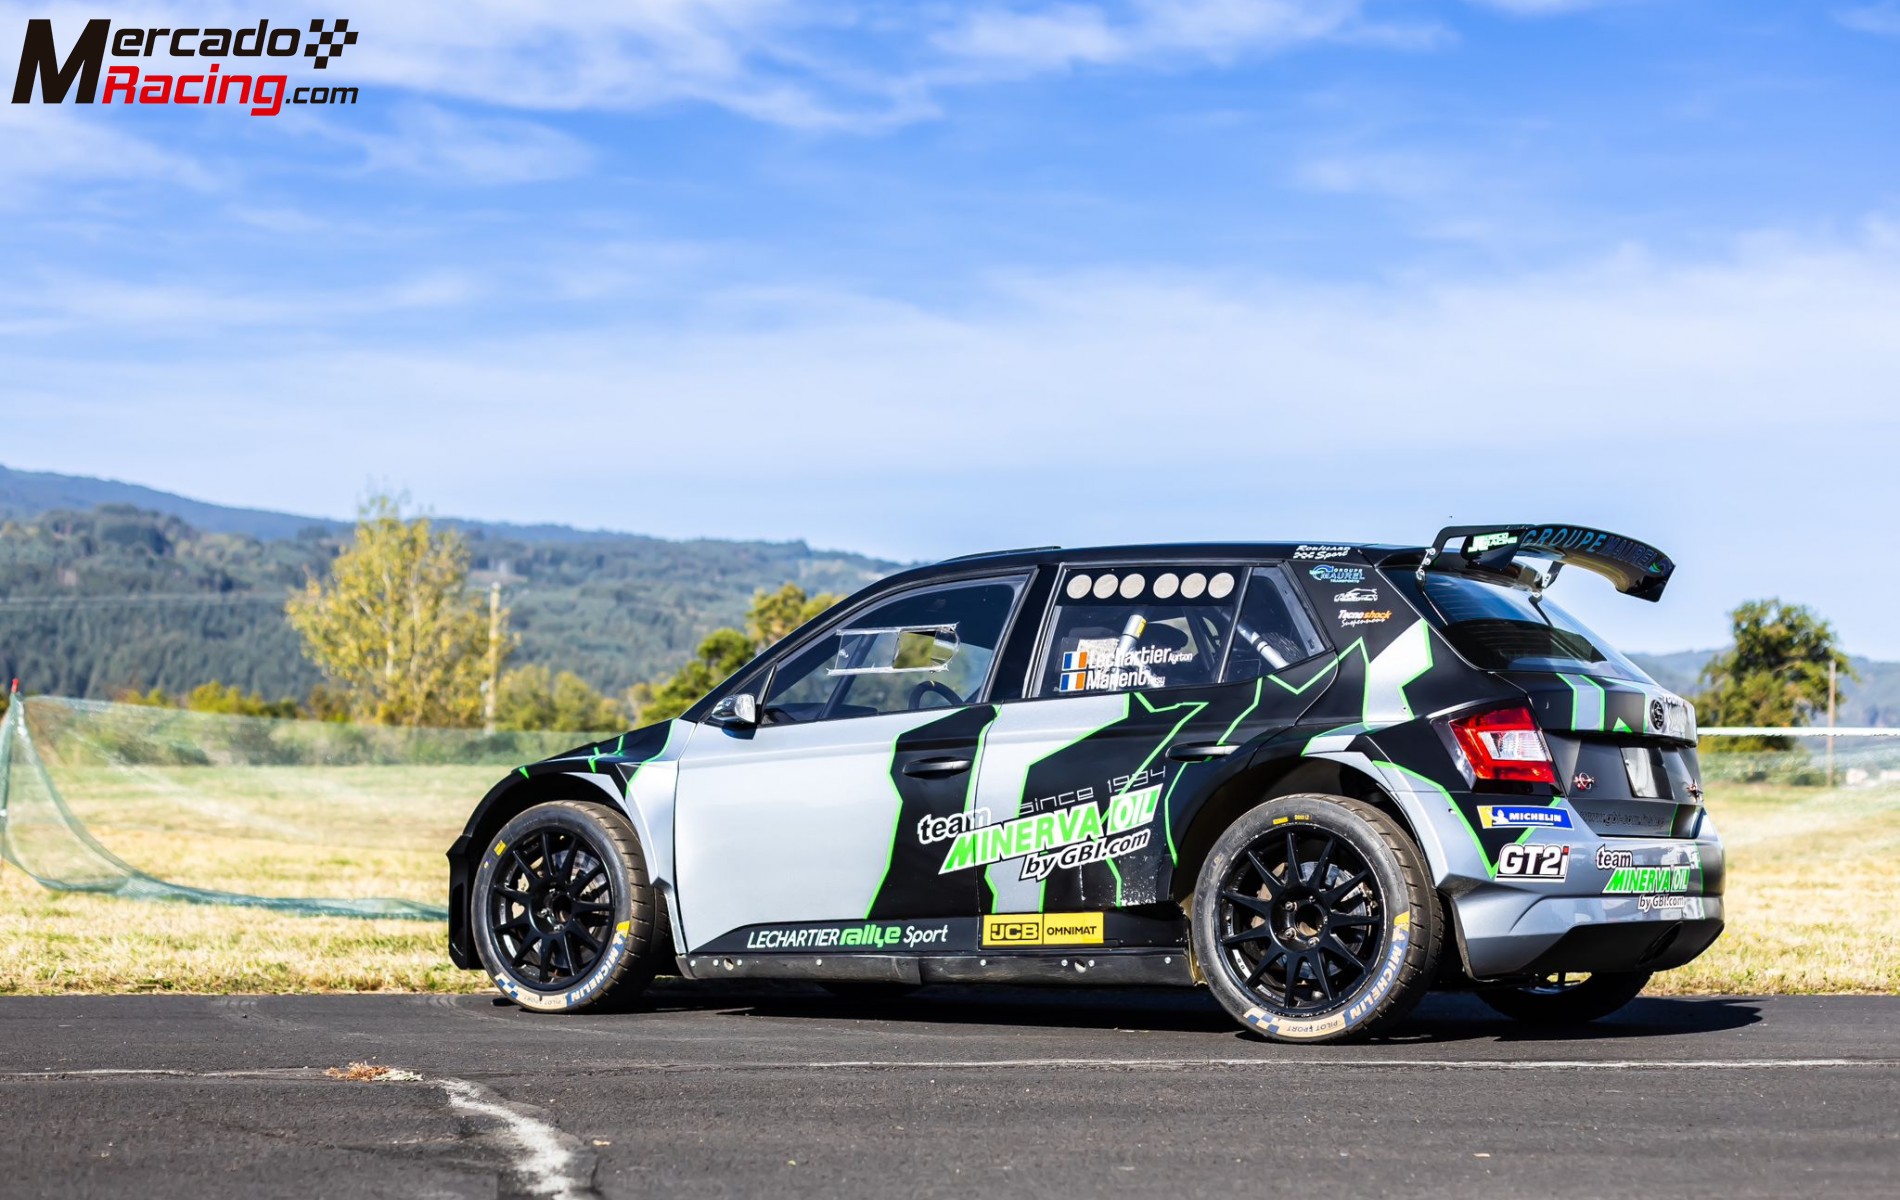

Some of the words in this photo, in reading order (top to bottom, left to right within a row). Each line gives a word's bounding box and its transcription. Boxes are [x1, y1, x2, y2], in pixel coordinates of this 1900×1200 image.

[1523, 528, 1607, 552] GROUPE
[1019, 786, 1094, 815] since
[919, 809, 990, 842] team
[940, 802, 1103, 873] MINERVA
[1108, 785, 1162, 834] OIL
[1508, 812, 1562, 822] MICHELIN
[1499, 844, 1569, 876] GT2i
[1597, 847, 1632, 867] team
[1604, 868, 1671, 892] MINERVA
[1671, 868, 1689, 892] OIL
[747, 929, 840, 949] LECHARTIER
[903, 924, 949, 948] Sport
[990, 922, 1040, 941] JCB
[1046, 926, 1097, 936] OMNIMAT
[571, 946, 619, 1002] MICHELIN
[1349, 944, 1403, 1021] MICHELIN
[1315, 1020, 1338, 1032] PILOT
